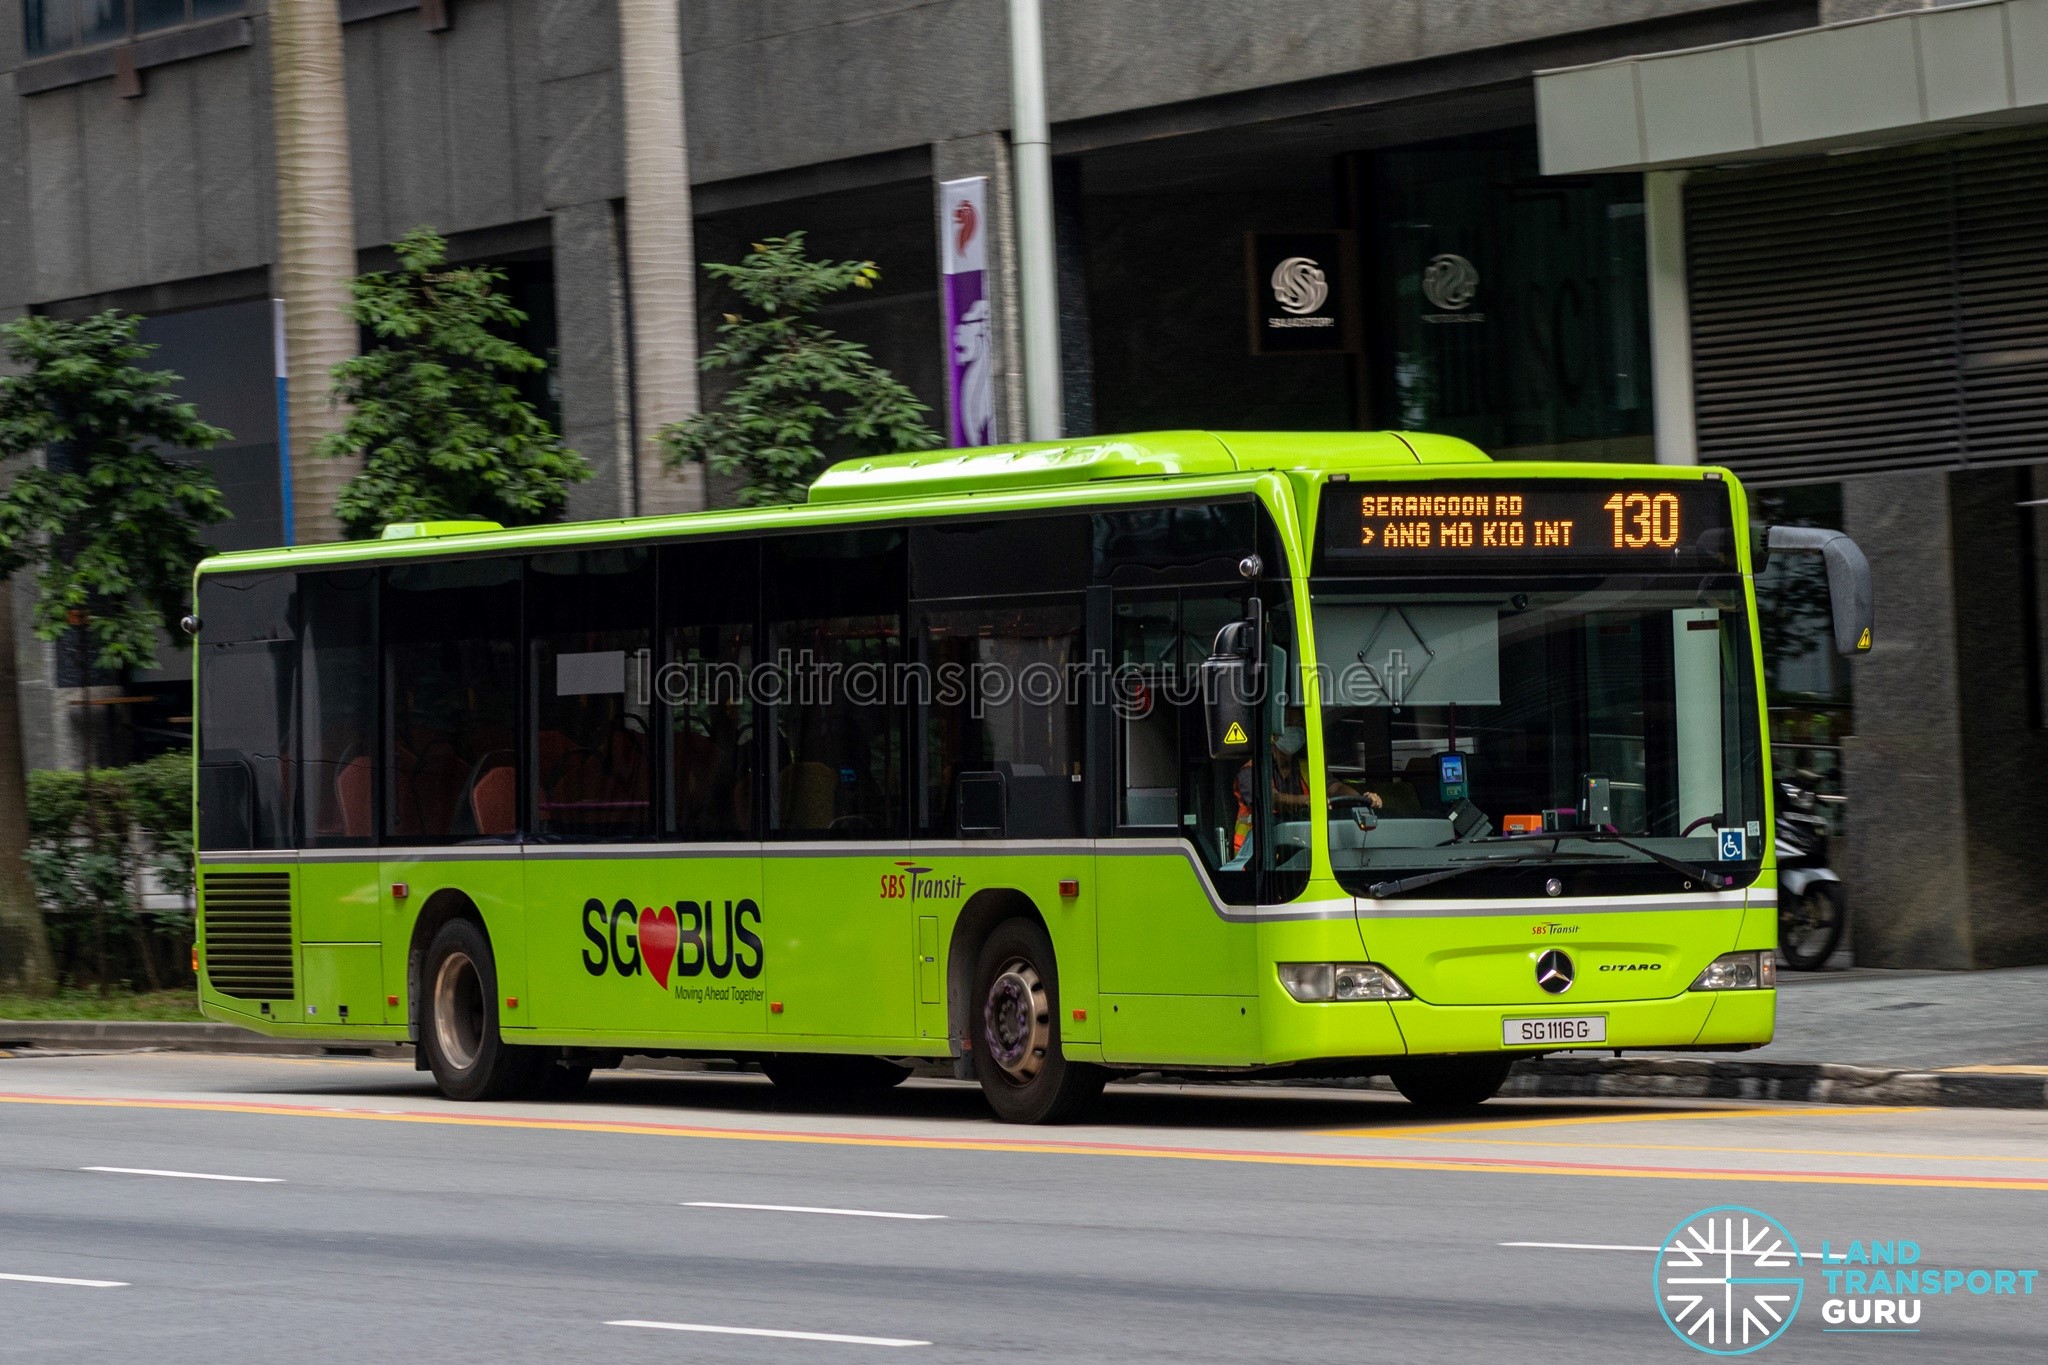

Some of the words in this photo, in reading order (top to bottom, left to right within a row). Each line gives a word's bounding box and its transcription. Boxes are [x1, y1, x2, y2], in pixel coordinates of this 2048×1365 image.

[1362, 496, 1488, 516] SERANGOON
[1496, 496, 1523, 516] RD
[1604, 493, 1679, 548] 130
[1384, 522, 1430, 546] ANG
[1441, 522, 1473, 546] MO
[1483, 521, 1524, 545] KIO
[1534, 521, 1573, 545] INT
[880, 873, 906, 899] SBS
[904, 867, 967, 902] Transit
[1532, 926, 1547, 935] SBS
[1547, 923, 1580, 935] Transit
[1599, 964, 1661, 972] CITARO
[675, 985, 703, 1003] Moving
[704, 986, 730, 1001] Ahead
[731, 986, 764, 1004] Together
